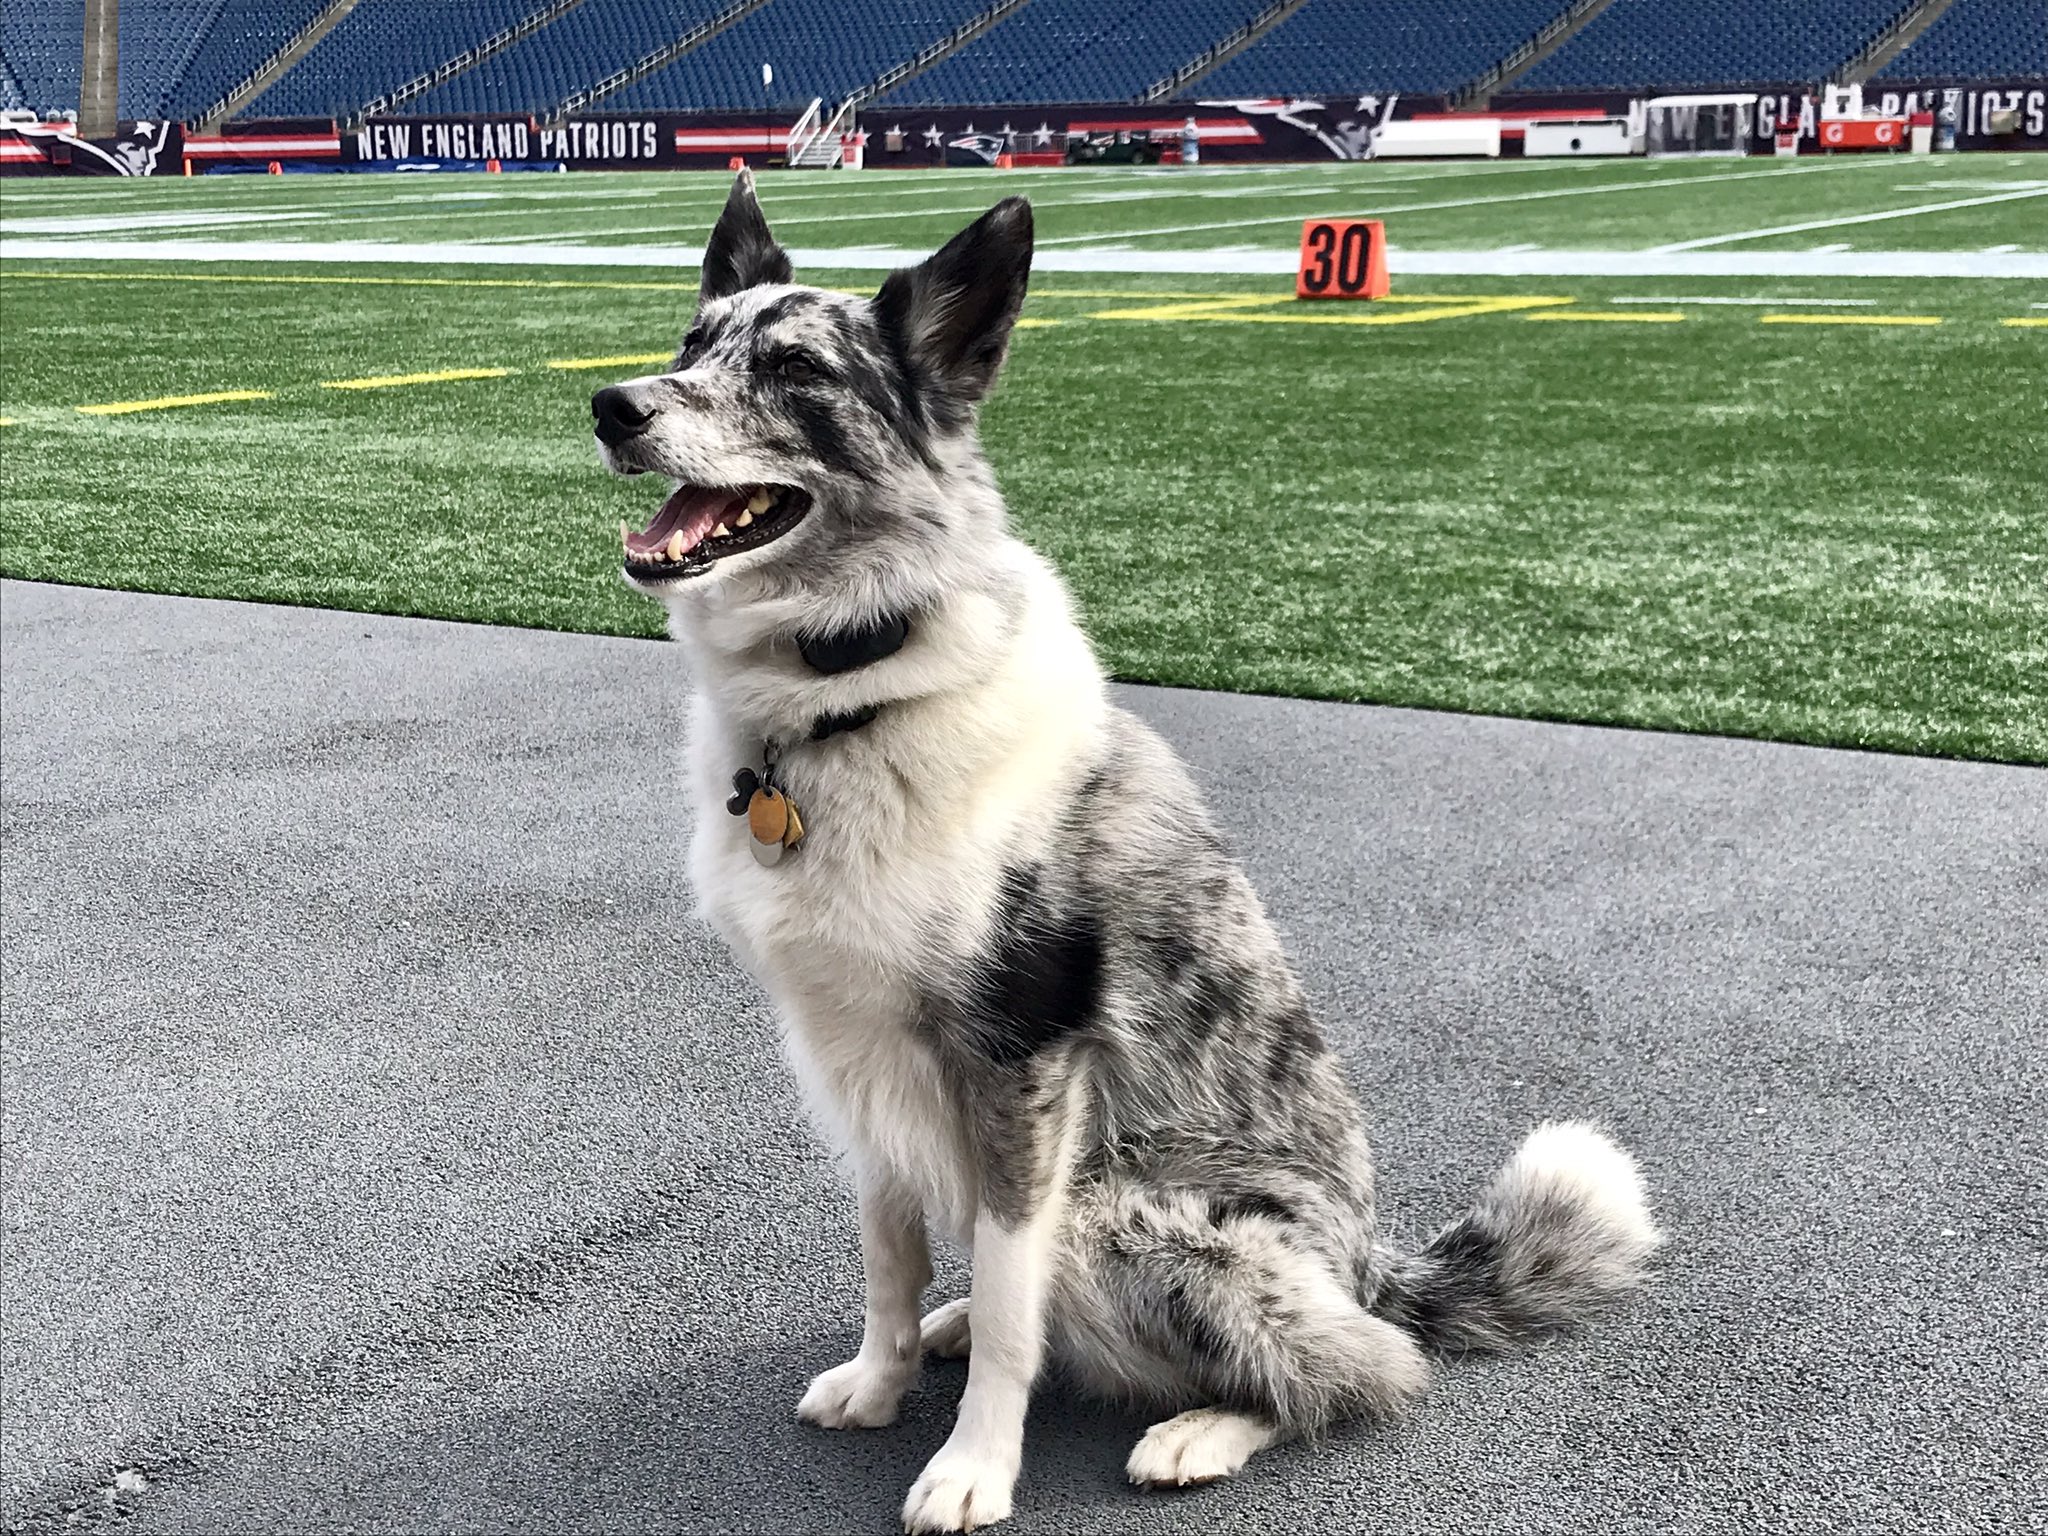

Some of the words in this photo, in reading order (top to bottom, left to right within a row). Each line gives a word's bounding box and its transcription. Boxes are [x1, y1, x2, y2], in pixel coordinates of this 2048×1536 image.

[357, 124, 410, 160] NEW
[422, 123, 529, 159] ENGLAND
[540, 122, 657, 159] PATRIOTS
[1304, 224, 1371, 293] 30
